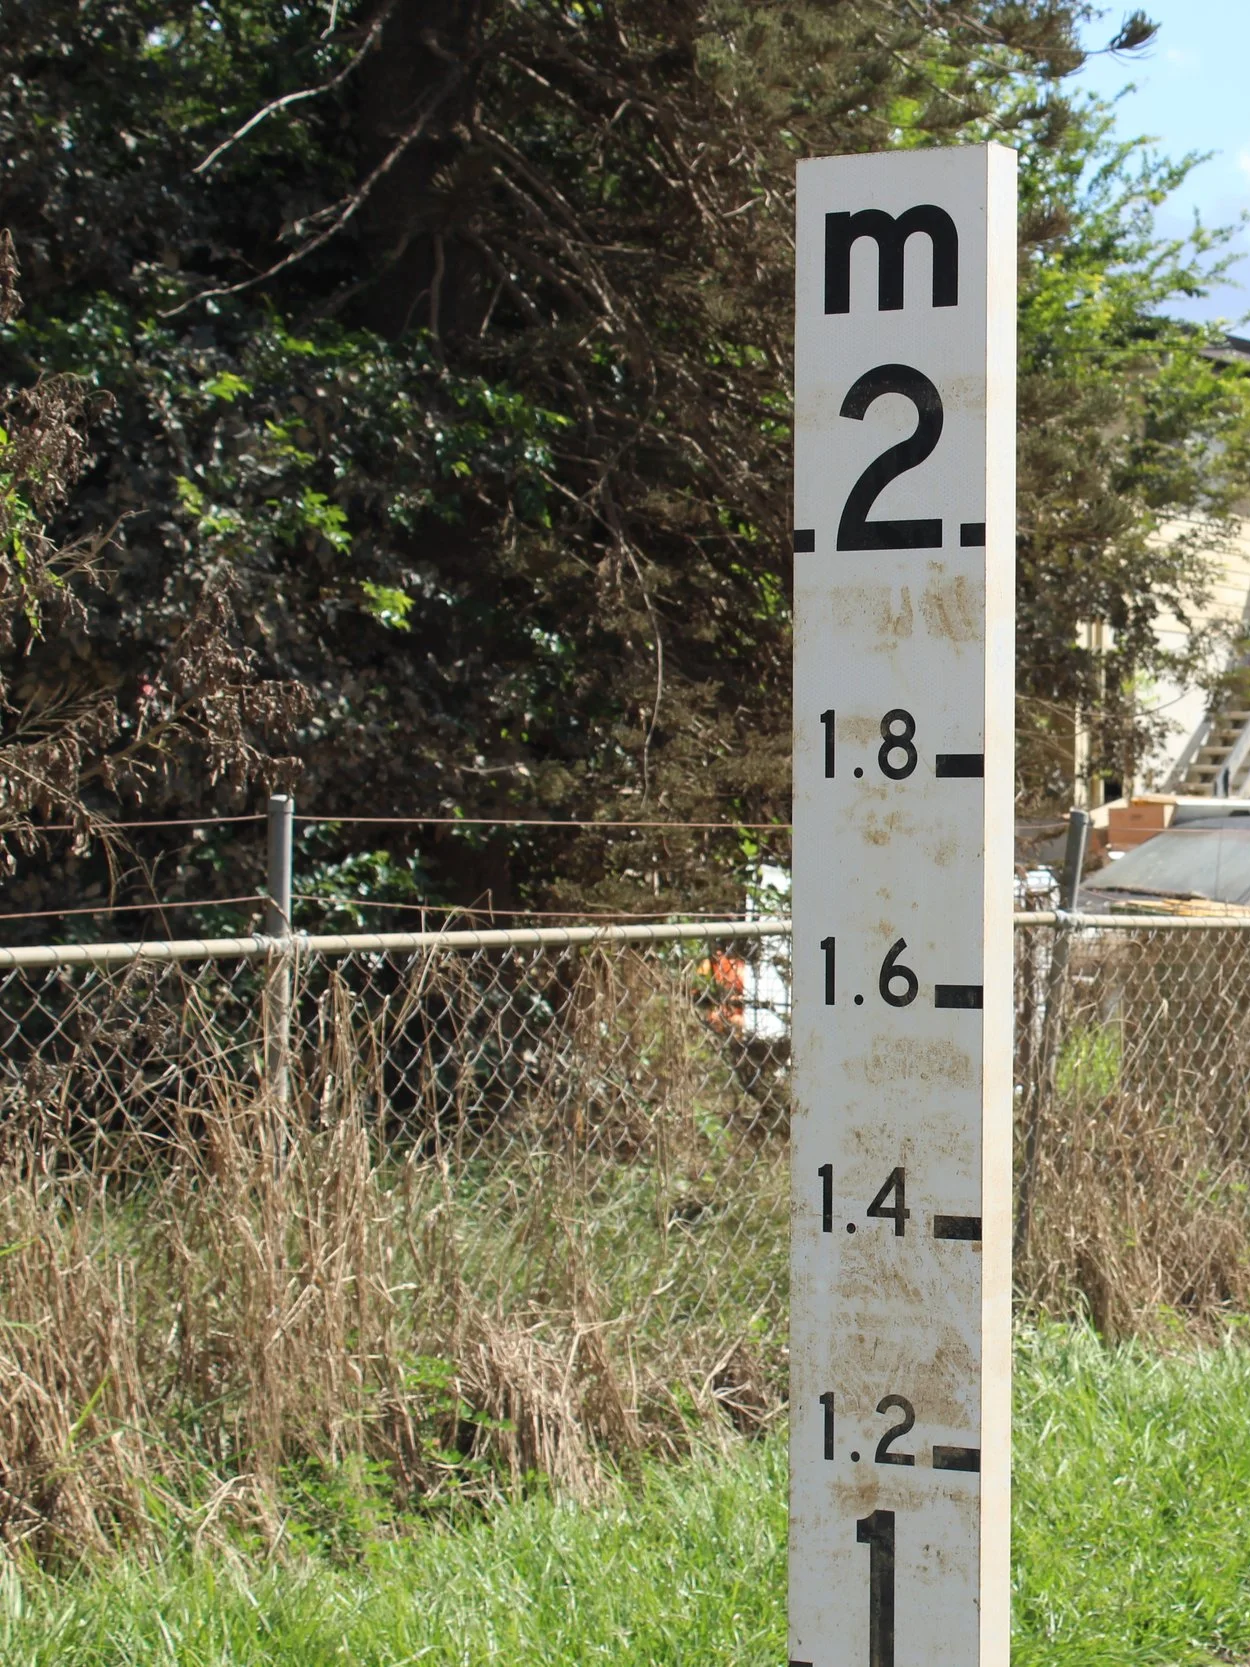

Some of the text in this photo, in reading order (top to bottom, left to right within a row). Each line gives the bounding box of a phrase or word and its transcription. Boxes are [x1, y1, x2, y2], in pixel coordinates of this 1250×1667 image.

[824, 204, 959, 315] m
[836, 363, 944, 552] 2
[820, 708, 919, 780] 1.8
[820, 936, 919, 1008] 1.6
[818, 1163, 911, 1237] 1.4
[819, 1391, 916, 1467] 1.2
[856, 1509, 895, 1667] 1
